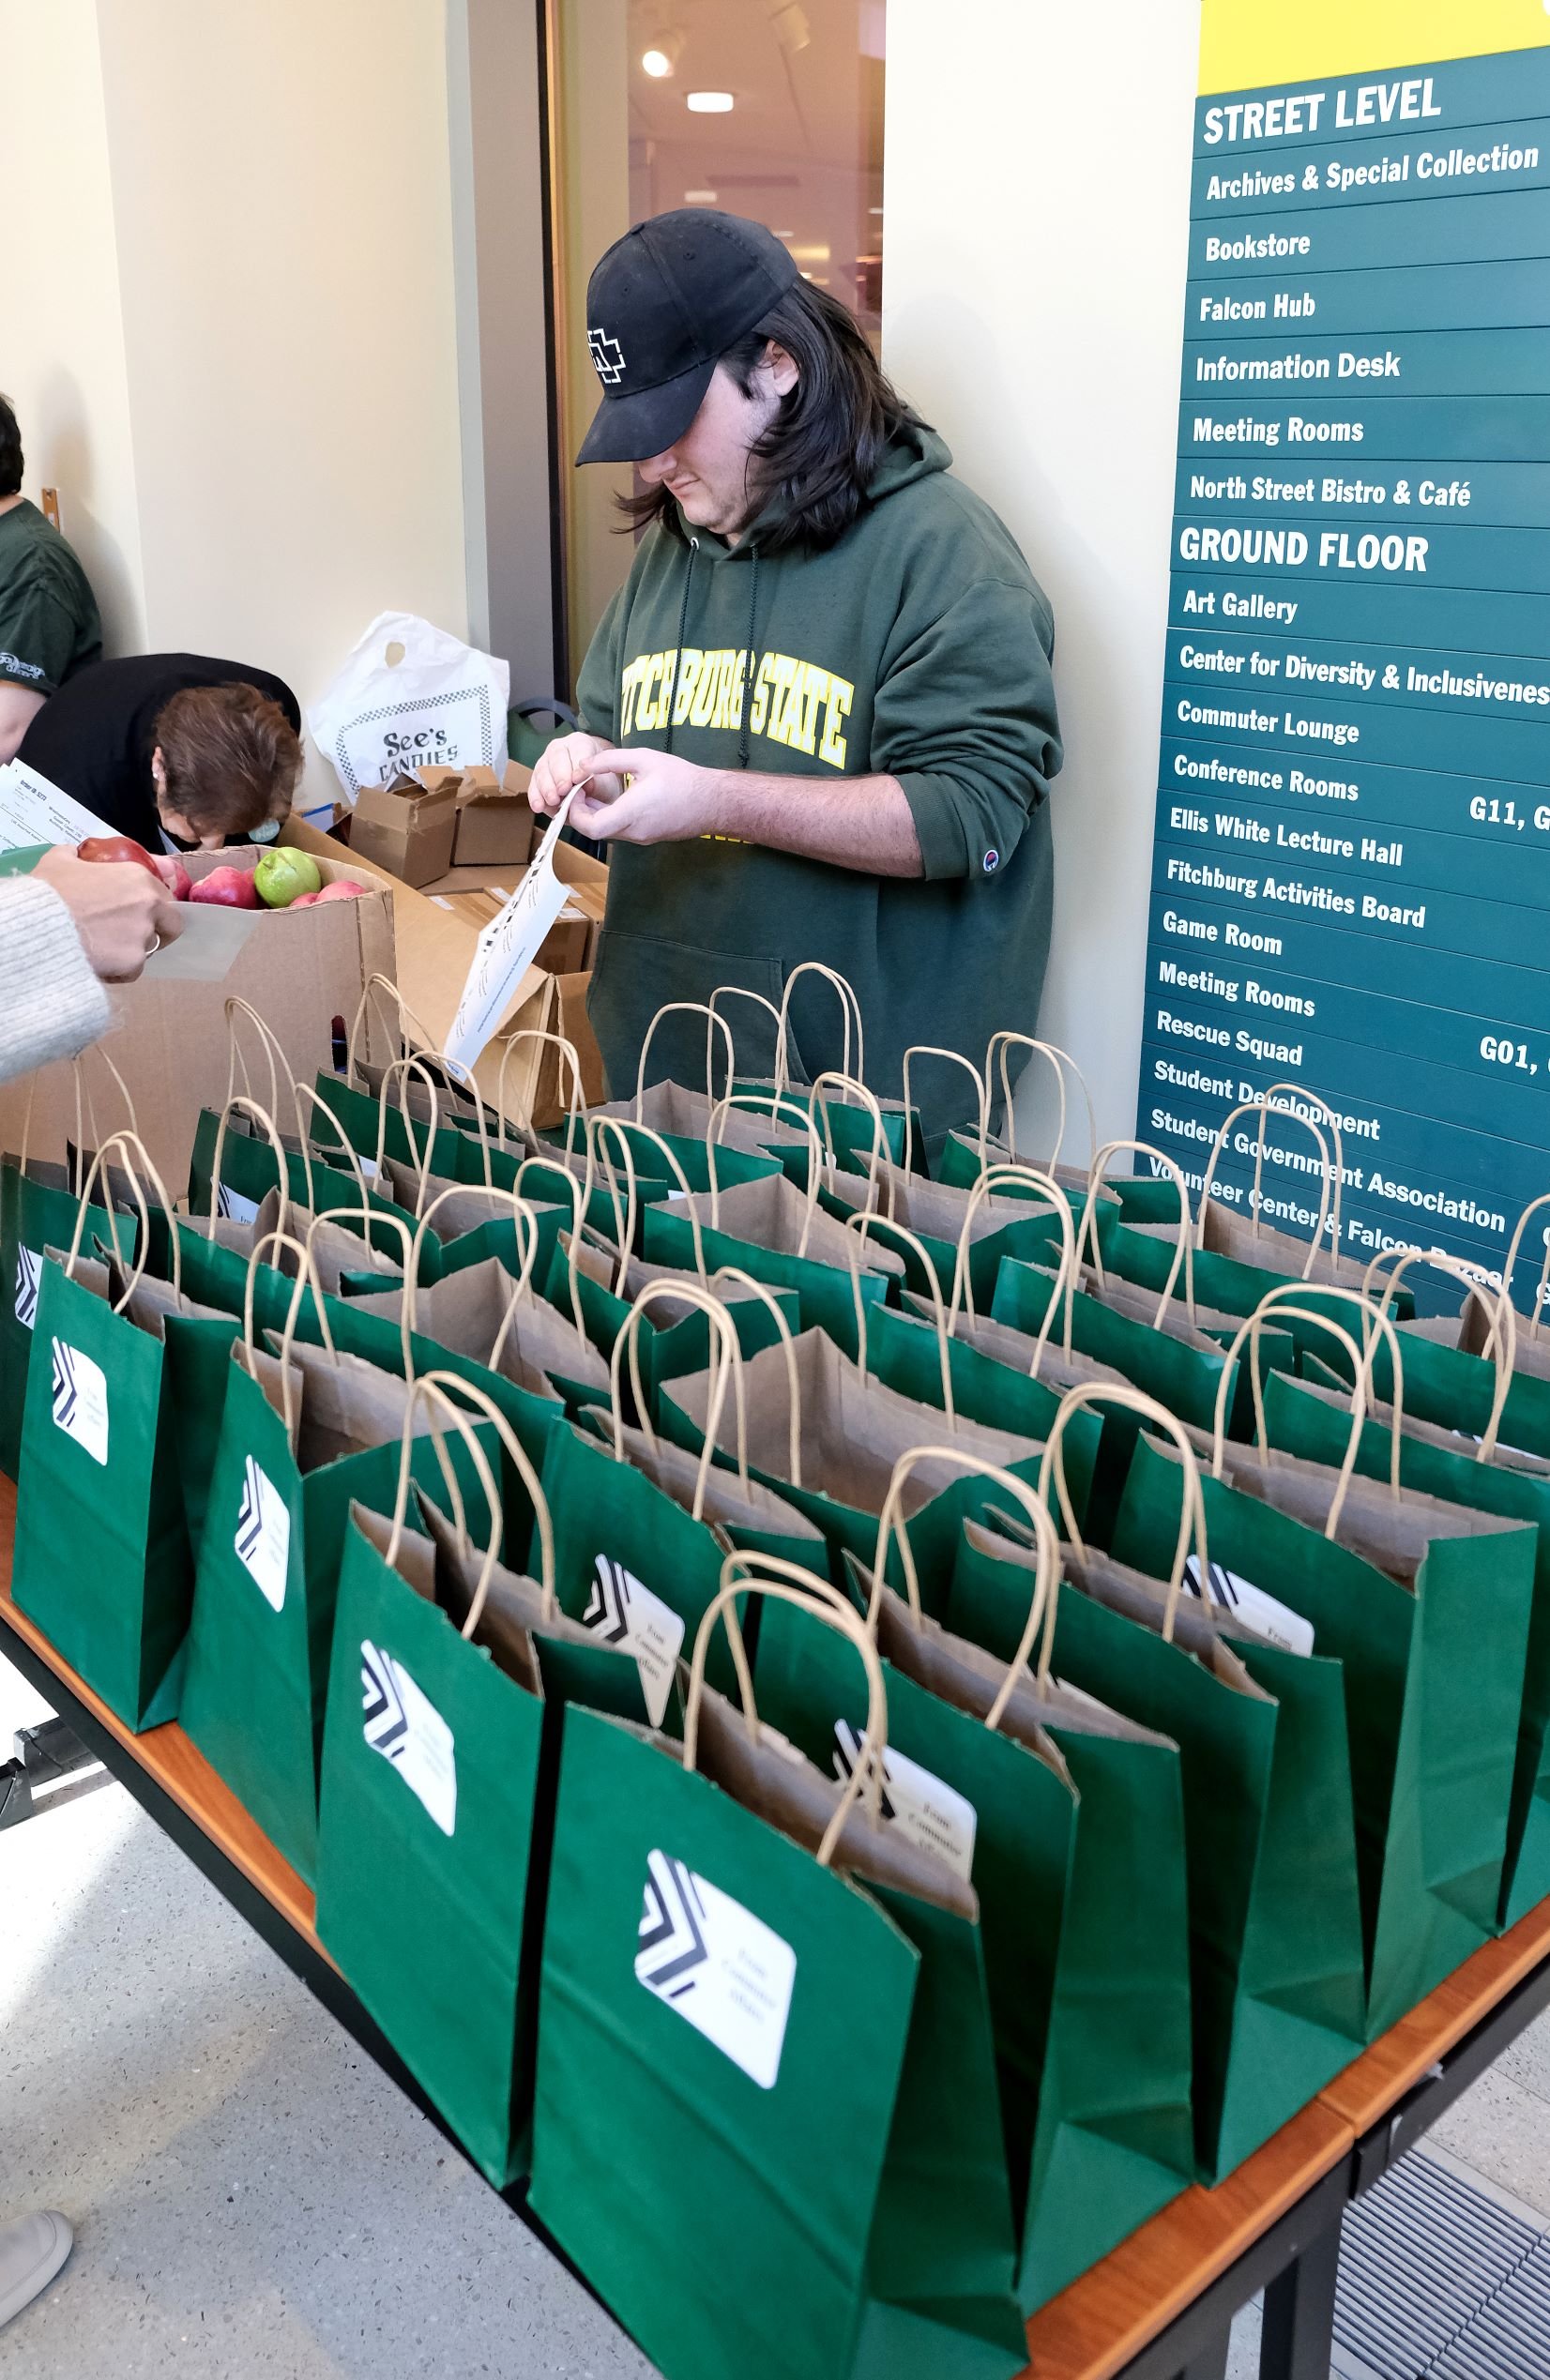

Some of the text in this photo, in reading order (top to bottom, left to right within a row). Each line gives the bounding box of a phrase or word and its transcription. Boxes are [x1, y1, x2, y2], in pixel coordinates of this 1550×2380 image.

[1203, 77, 1442, 144] STREET LEVEL
[1206, 143, 1540, 201] Archives & Special Collection
[1206, 233, 1311, 262] Bookstore
[1200, 292, 1316, 322] Falcon Hub
[1196, 351, 1402, 382] Information Desk
[1193, 417, 1364, 447] Meeting Rooms
[1190, 476, 1471, 508] North Street Bistro & Café
[1179, 526, 1429, 572] GROUND FLOOR
[1182, 589, 1299, 625] Art Gallery
[1179, 644, 1246, 674] Center
[1249, 651, 1281, 676] for
[1284, 654, 1376, 691] Diversity
[1381, 663, 1400, 690] &
[750, 651, 855, 770] STATE
[1178, 700, 1360, 746] Commuter Lounge
[379, 744, 458, 782] CANDIES
[383, 728, 448, 758] See's
[1174, 754, 1359, 801] Conference Rooms
[1469, 796, 1526, 831] G11,
[1170, 807, 1404, 867] Ellis White Lecture Hall
[1167, 858, 1426, 928] Fitchburg Activities Board
[1162, 910, 1283, 956] Game Room
[1159, 961, 1315, 1017] Meeting Rooms
[1157, 1010, 1303, 1067] Rescue Squad
[1480, 1036, 1538, 1075] G01,
[1154, 1060, 1234, 1099] Student
[1248, 1187, 1319, 1230] Center
[1366, 1173, 1506, 1234] Association
